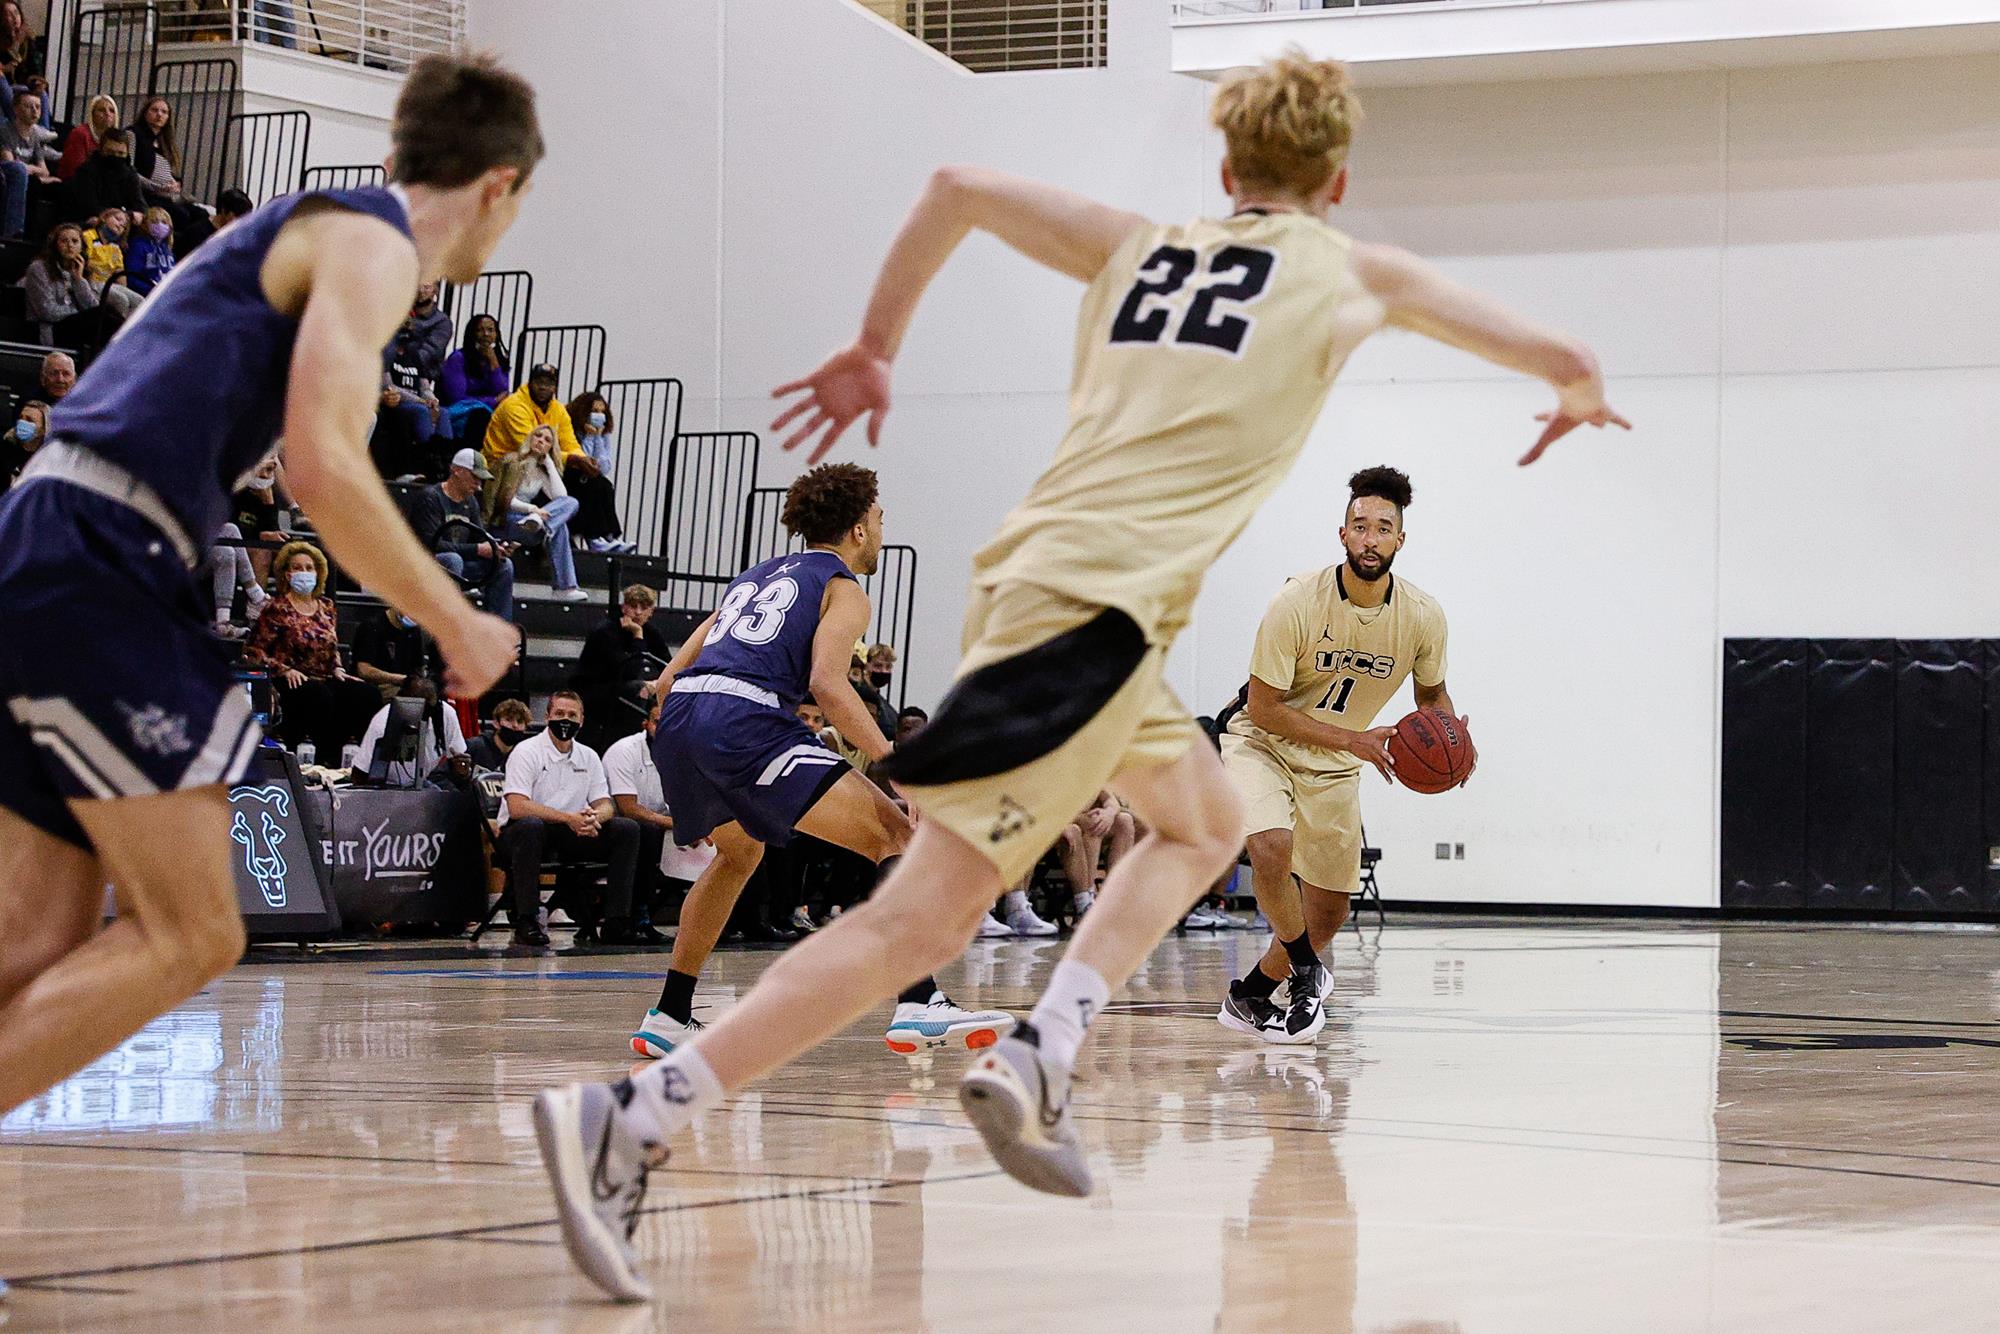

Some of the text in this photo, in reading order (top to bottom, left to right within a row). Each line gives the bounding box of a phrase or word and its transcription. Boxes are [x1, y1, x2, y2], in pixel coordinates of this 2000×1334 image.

[1108, 243, 1278, 358] 22
[703, 577, 799, 645] 33
[1315, 648, 1395, 680] UCCS
[1313, 675, 1357, 715] 11
[1432, 706, 1459, 747] lson
[319, 817, 446, 881] E IT YOURS
